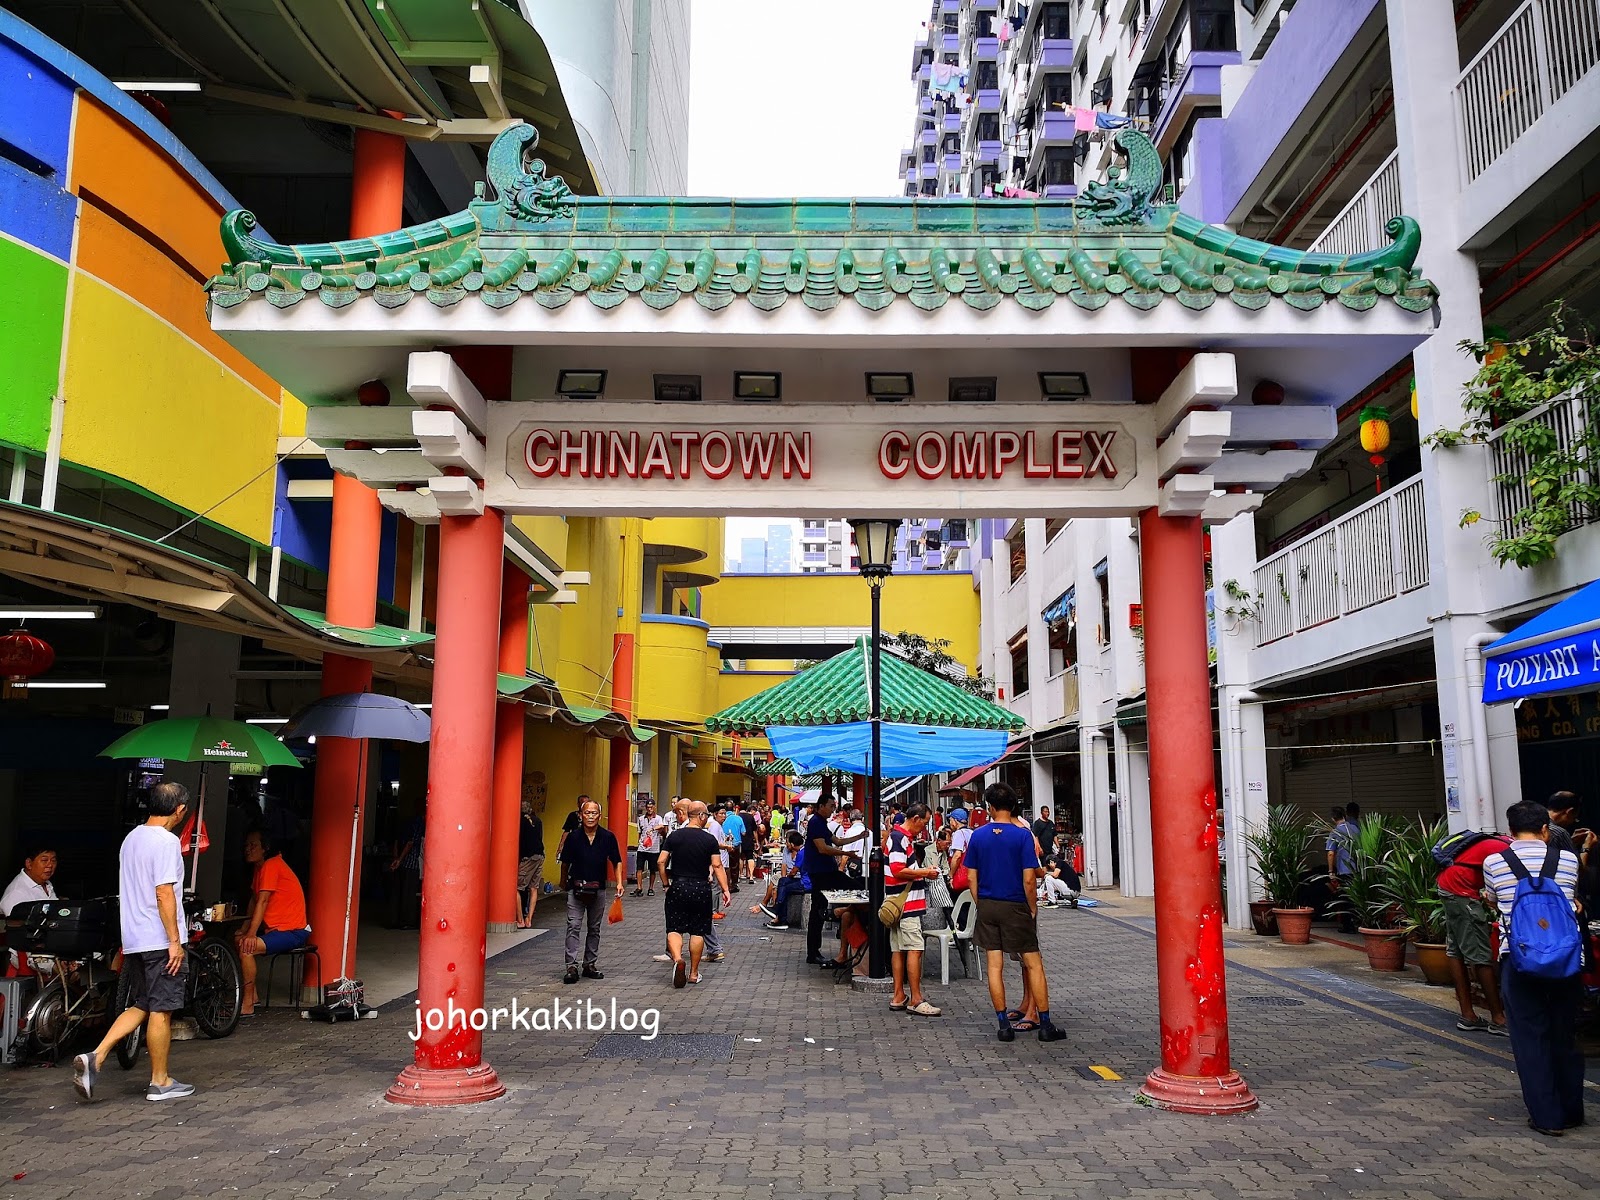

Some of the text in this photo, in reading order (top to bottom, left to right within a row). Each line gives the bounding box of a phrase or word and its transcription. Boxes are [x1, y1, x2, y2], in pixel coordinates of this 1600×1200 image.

[524, 428, 1118, 480] CHINATOWN COMPLEX
[1498, 645, 1580, 690] POLYART
[203, 748, 248, 758] Heineken
